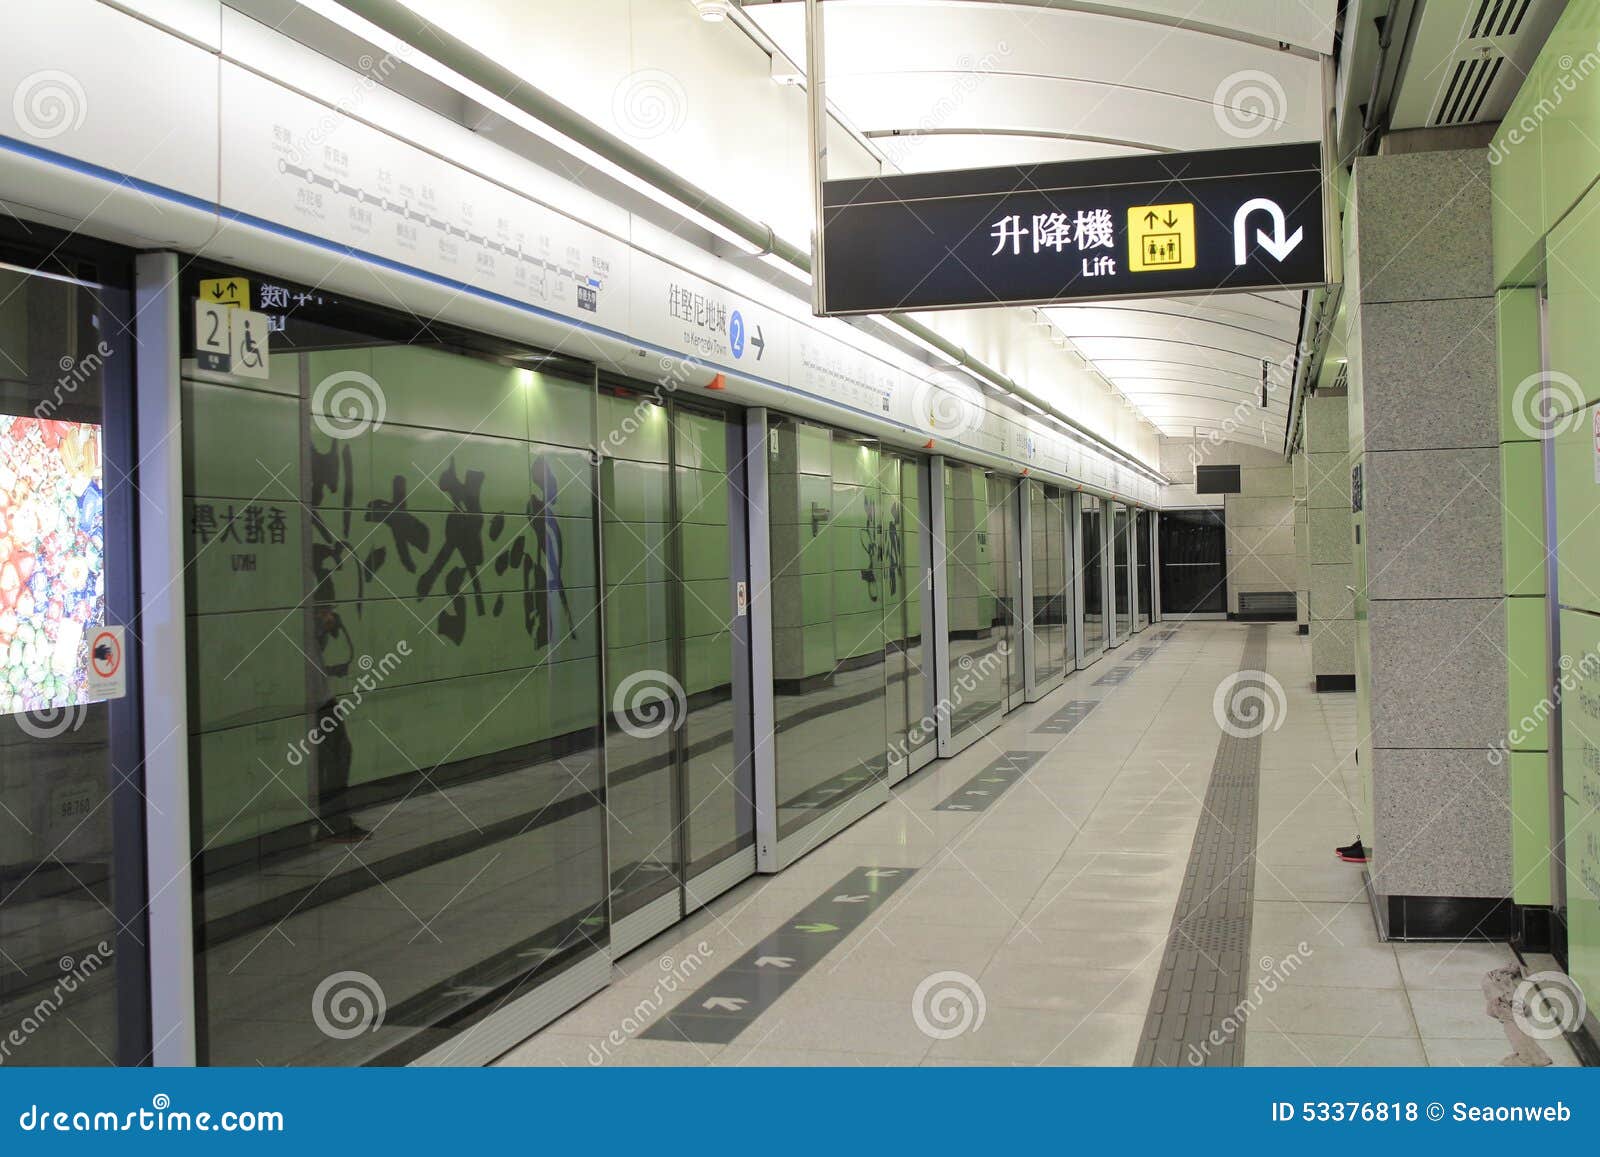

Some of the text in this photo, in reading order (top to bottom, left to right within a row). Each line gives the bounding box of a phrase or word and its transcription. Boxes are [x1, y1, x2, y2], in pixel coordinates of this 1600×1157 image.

[990, 209, 1114, 256] 升降機
[1082, 257, 1116, 277] Lift
[669, 283, 726, 336] 往堅尼地城
[206, 310, 220, 346] 2
[733, 319, 741, 350] 2
